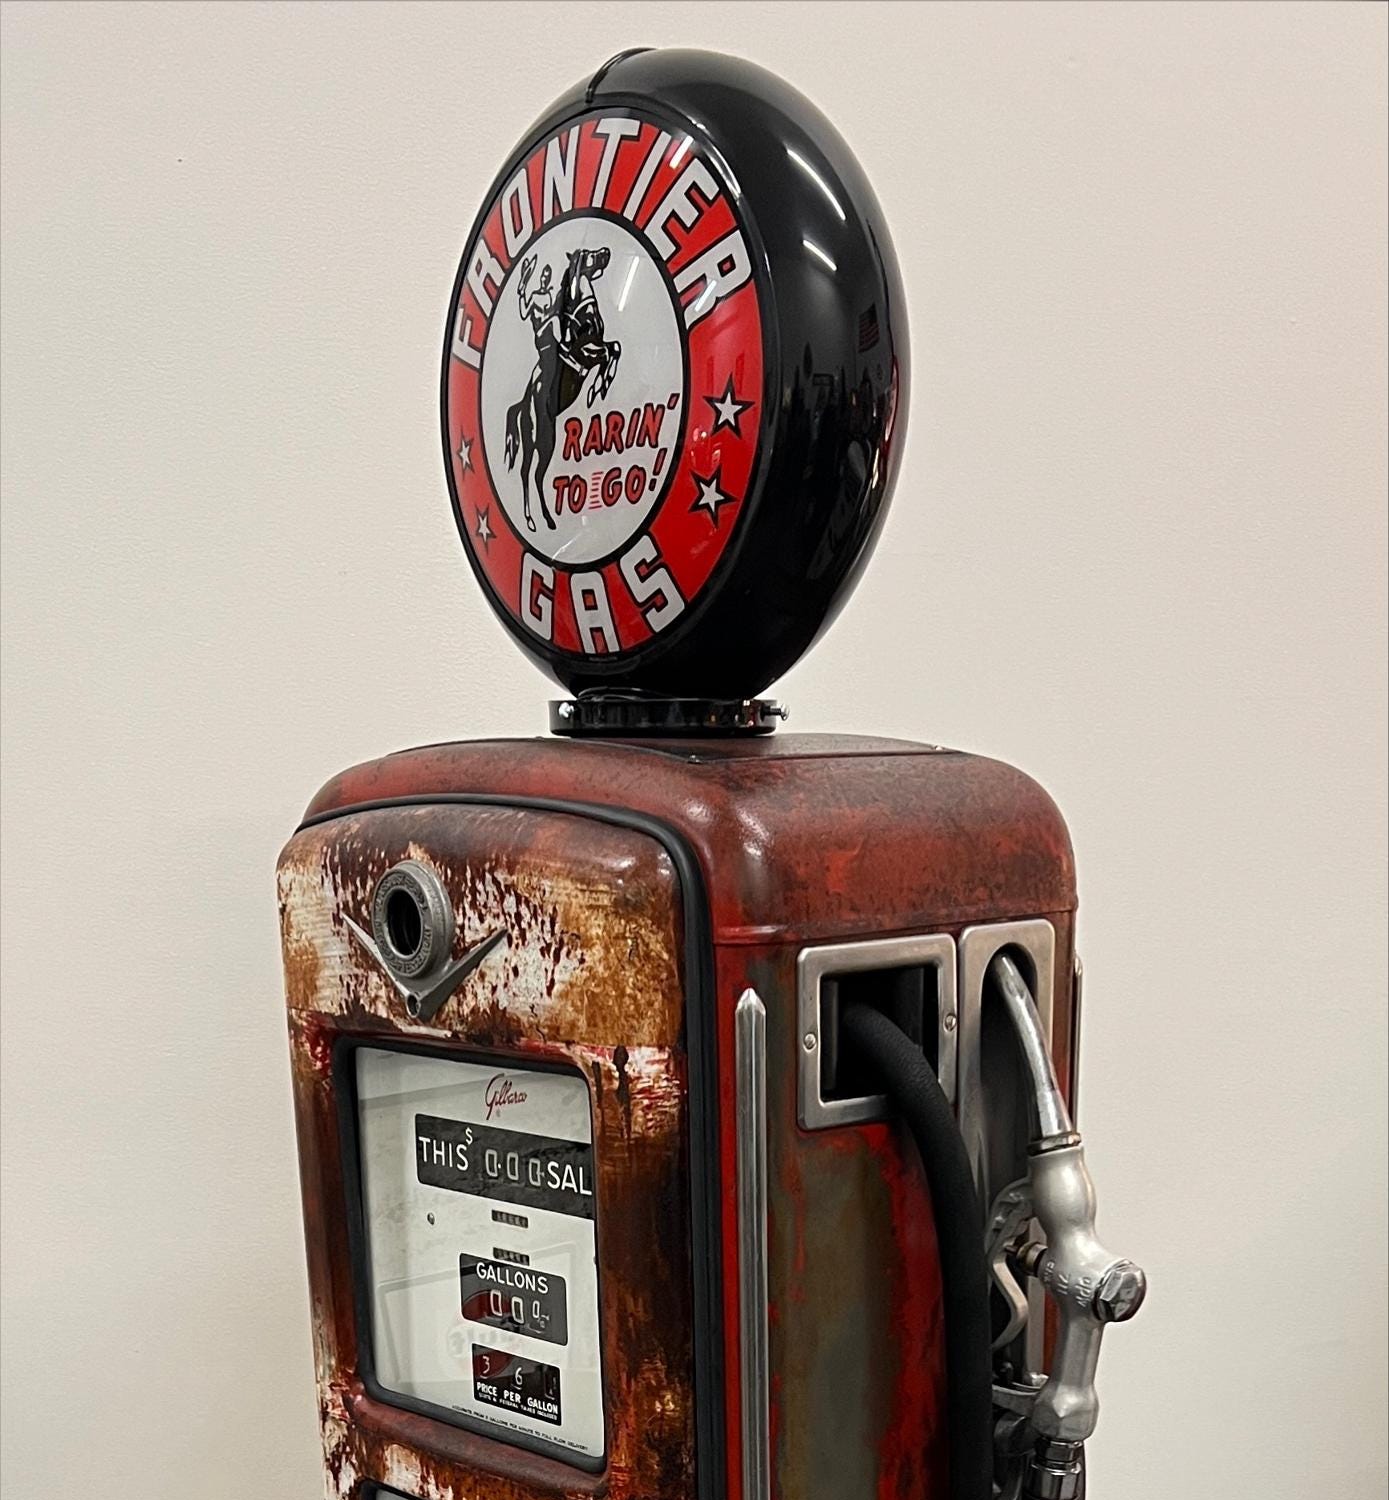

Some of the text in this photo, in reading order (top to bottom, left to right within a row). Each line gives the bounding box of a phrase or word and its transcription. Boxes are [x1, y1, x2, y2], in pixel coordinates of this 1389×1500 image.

[453, 117, 753, 369] FRONTIER
[563, 393, 680, 462] RARIN'
[553, 448, 667, 515] TO GO!
[521, 535, 687, 654] GAS
[418, 1136, 469, 1171] THIS
[547, 1161, 593, 1196] SAL
[465, 1127, 473, 1145] $
[476, 1262, 549, 1294] GALLONS
[476, 1381, 559, 1415] PRICE PER GALLON
